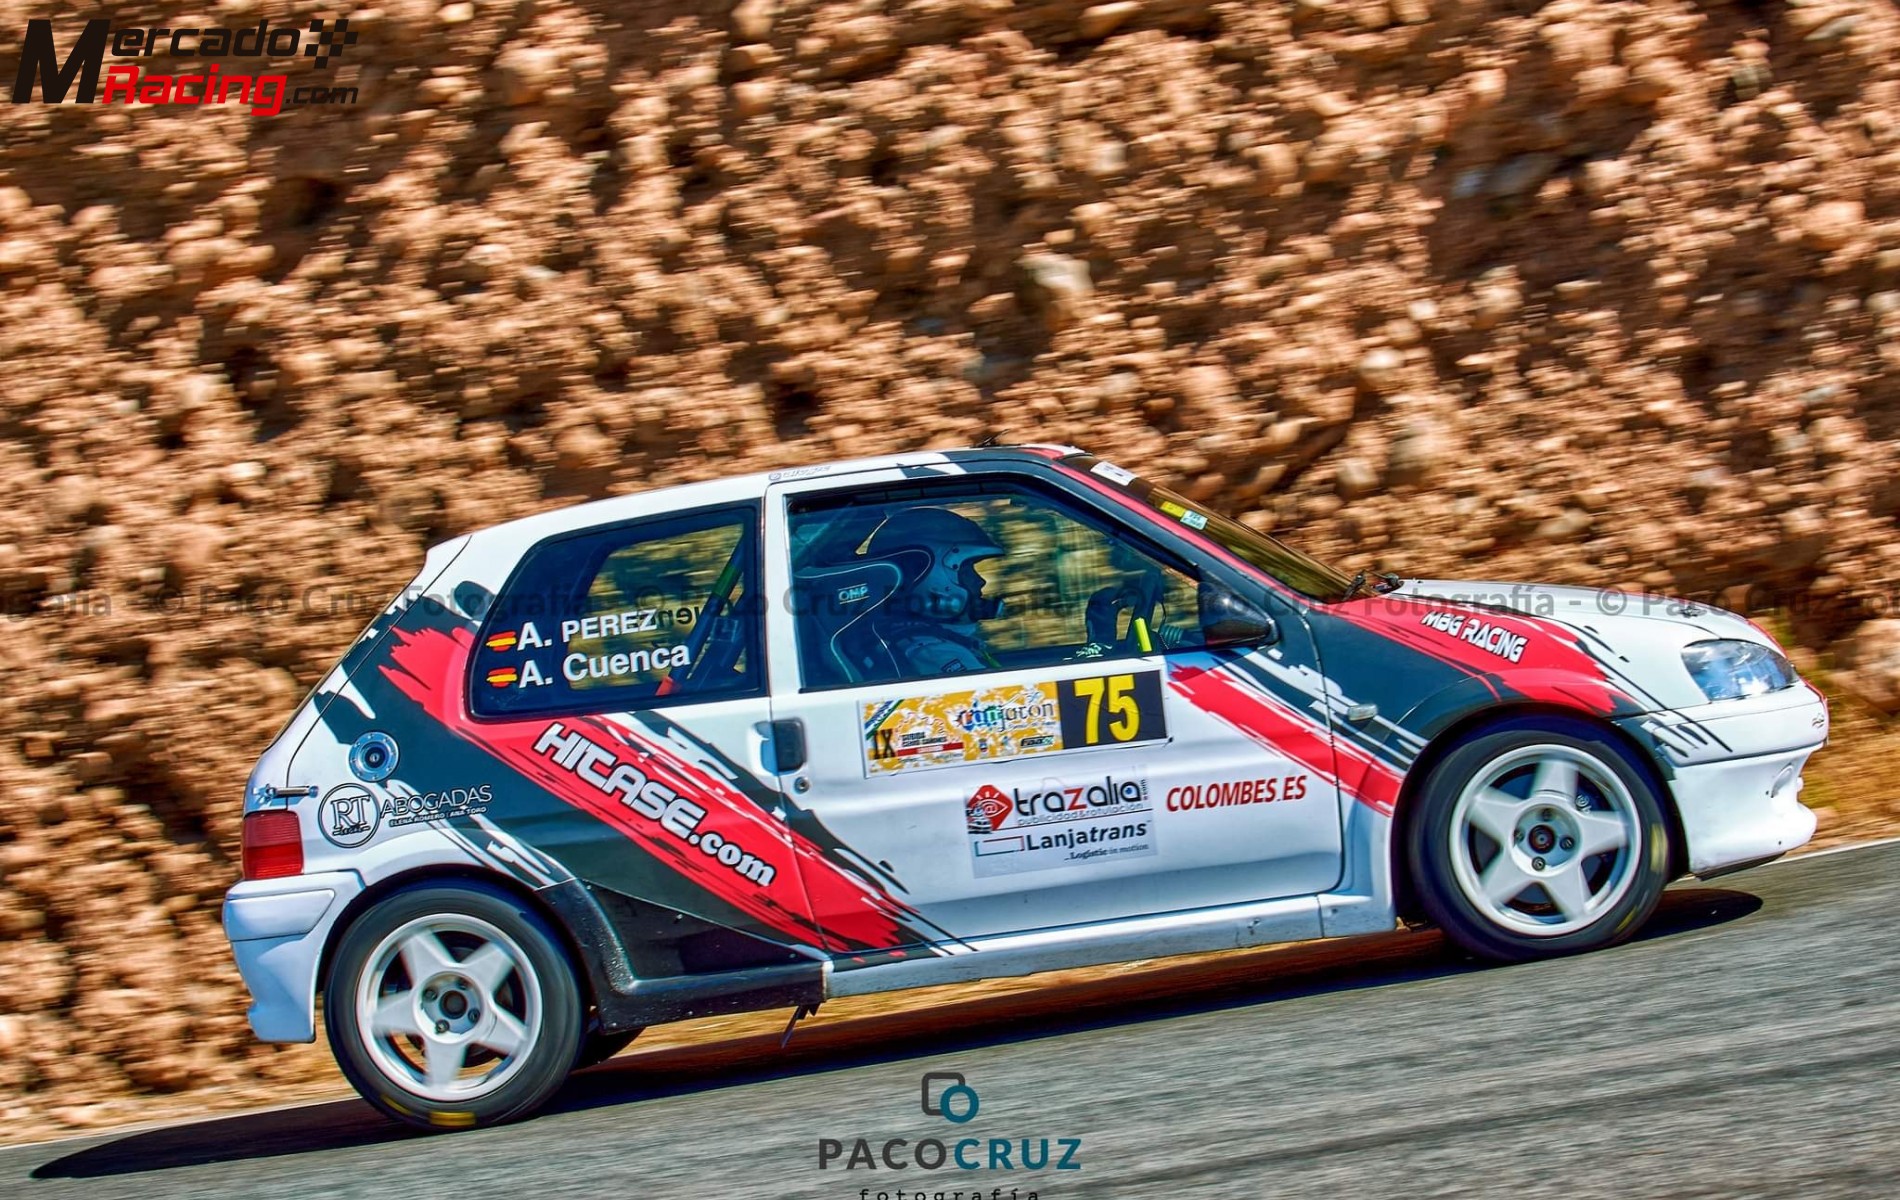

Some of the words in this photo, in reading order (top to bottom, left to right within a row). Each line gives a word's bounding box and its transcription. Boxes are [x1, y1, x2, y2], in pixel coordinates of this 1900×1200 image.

[838, 587, 869, 601] OMP
[517, 621, 553, 651] A.
[561, 608, 658, 643] PEREZ
[1459, 617, 1529, 664] RACING
[518, 659, 554, 689] A.
[562, 643, 691, 682] Cuenca
[1073, 673, 1141, 745] 75
[873, 727, 897, 760] IX
[330, 795, 371, 830] RT
[380, 784, 493, 819] ABOGADAS
[533, 722, 778, 888] HITASE.com
[1013, 775, 1142, 816] trazalia
[1166, 775, 1308, 813] COLOMBES.ES
[414, 812, 445, 824] ROMERO
[1026, 822, 1148, 851] Lanjatrans
